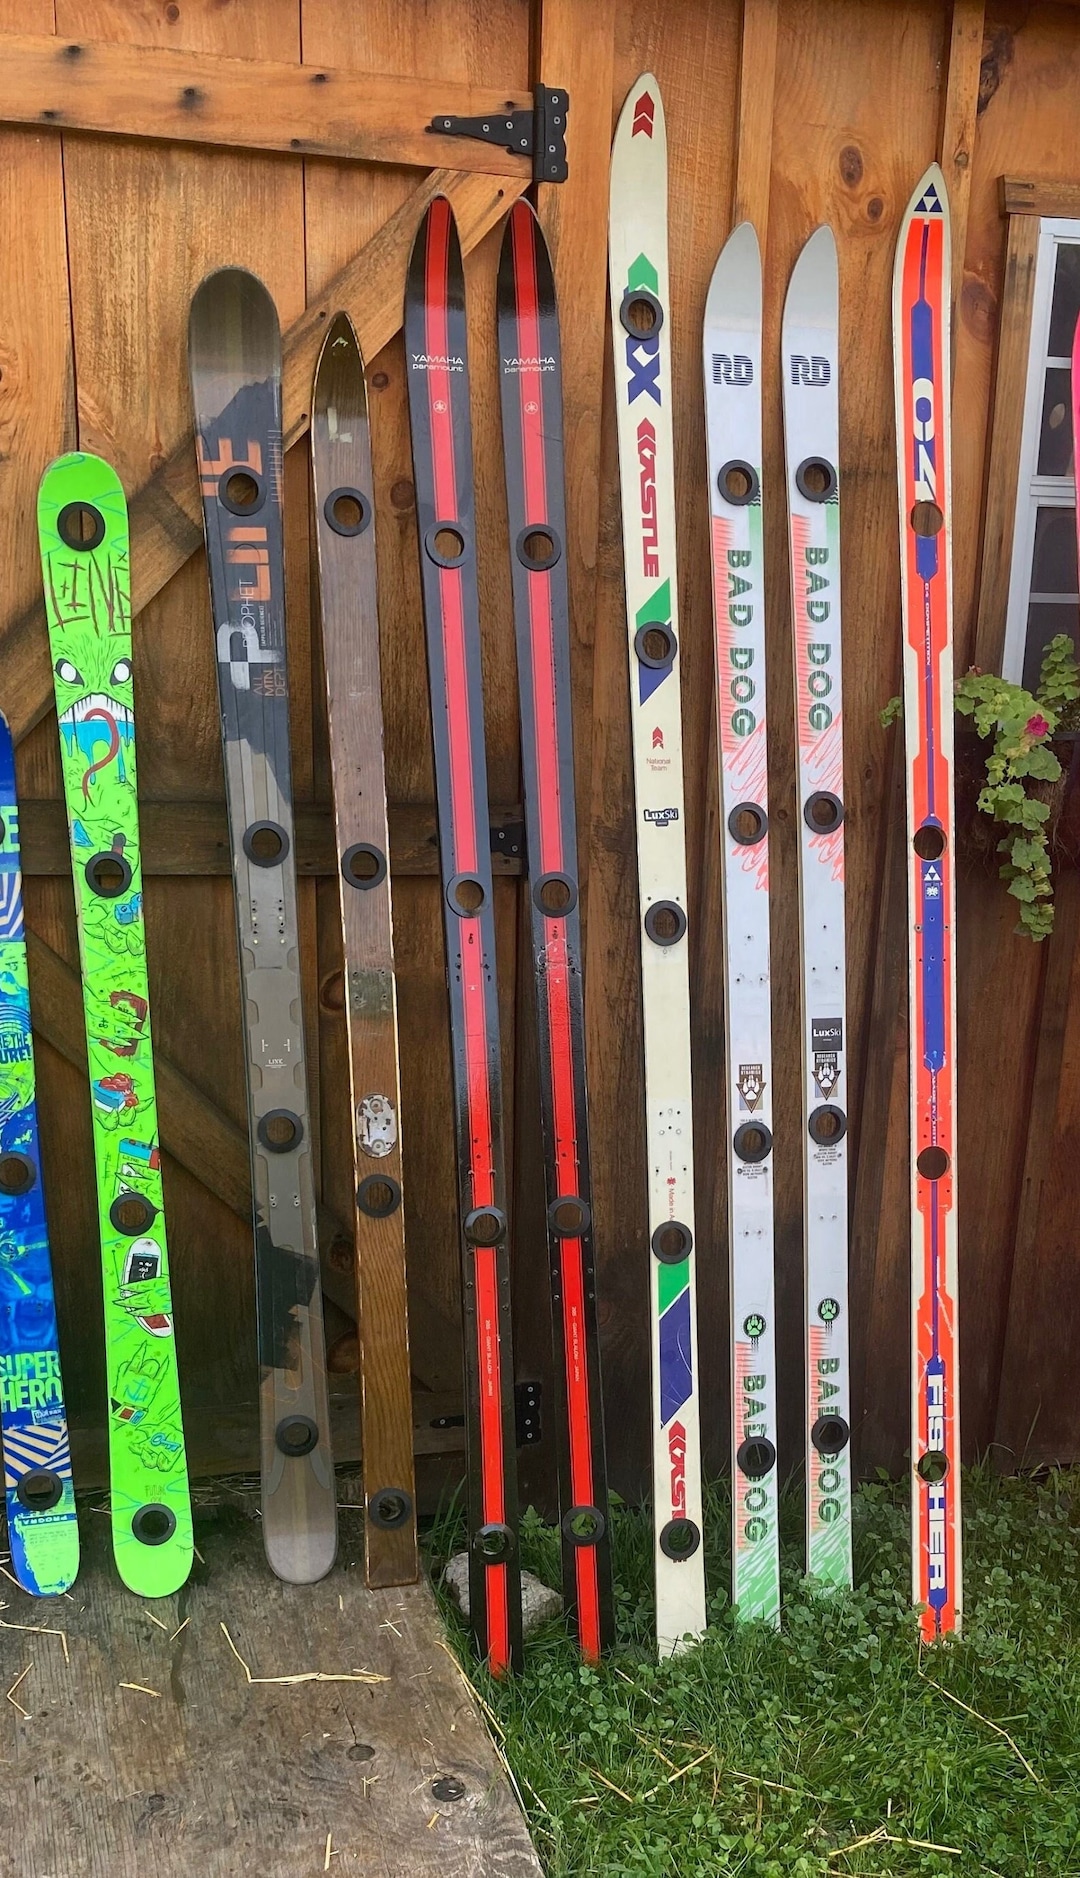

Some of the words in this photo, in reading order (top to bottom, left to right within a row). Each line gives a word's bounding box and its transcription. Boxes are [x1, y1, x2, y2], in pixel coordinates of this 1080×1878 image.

[411, 353, 464, 365] YAMAHA
[412, 362, 464, 373] paramount
[503, 354, 556, 366] YAMAHA
[504, 363, 556, 374] paramount
[711, 352, 754, 387] RD
[790, 353, 831, 387] RD
[727, 549, 754, 628] BAD
[805, 546, 831, 624] BAD
[239, 578, 256, 649] PROPHET
[252, 676, 264, 696] ALL
[263, 669, 275, 697] MTN
[273, 667, 287, 697] DEPT
[729, 647, 756, 738] DOG
[806, 643, 833, 731] DOG
[646, 757, 671, 765] National
[644, 809, 679, 821] LuxSki
[813, 1028, 841, 1037] LuxSki
[0, 1351, 61, 1382] SUPER
[1, 1377, 63, 1413] HERO
[926, 1374, 947, 1592] FISHER
[744, 1475, 768, 1542] OG
